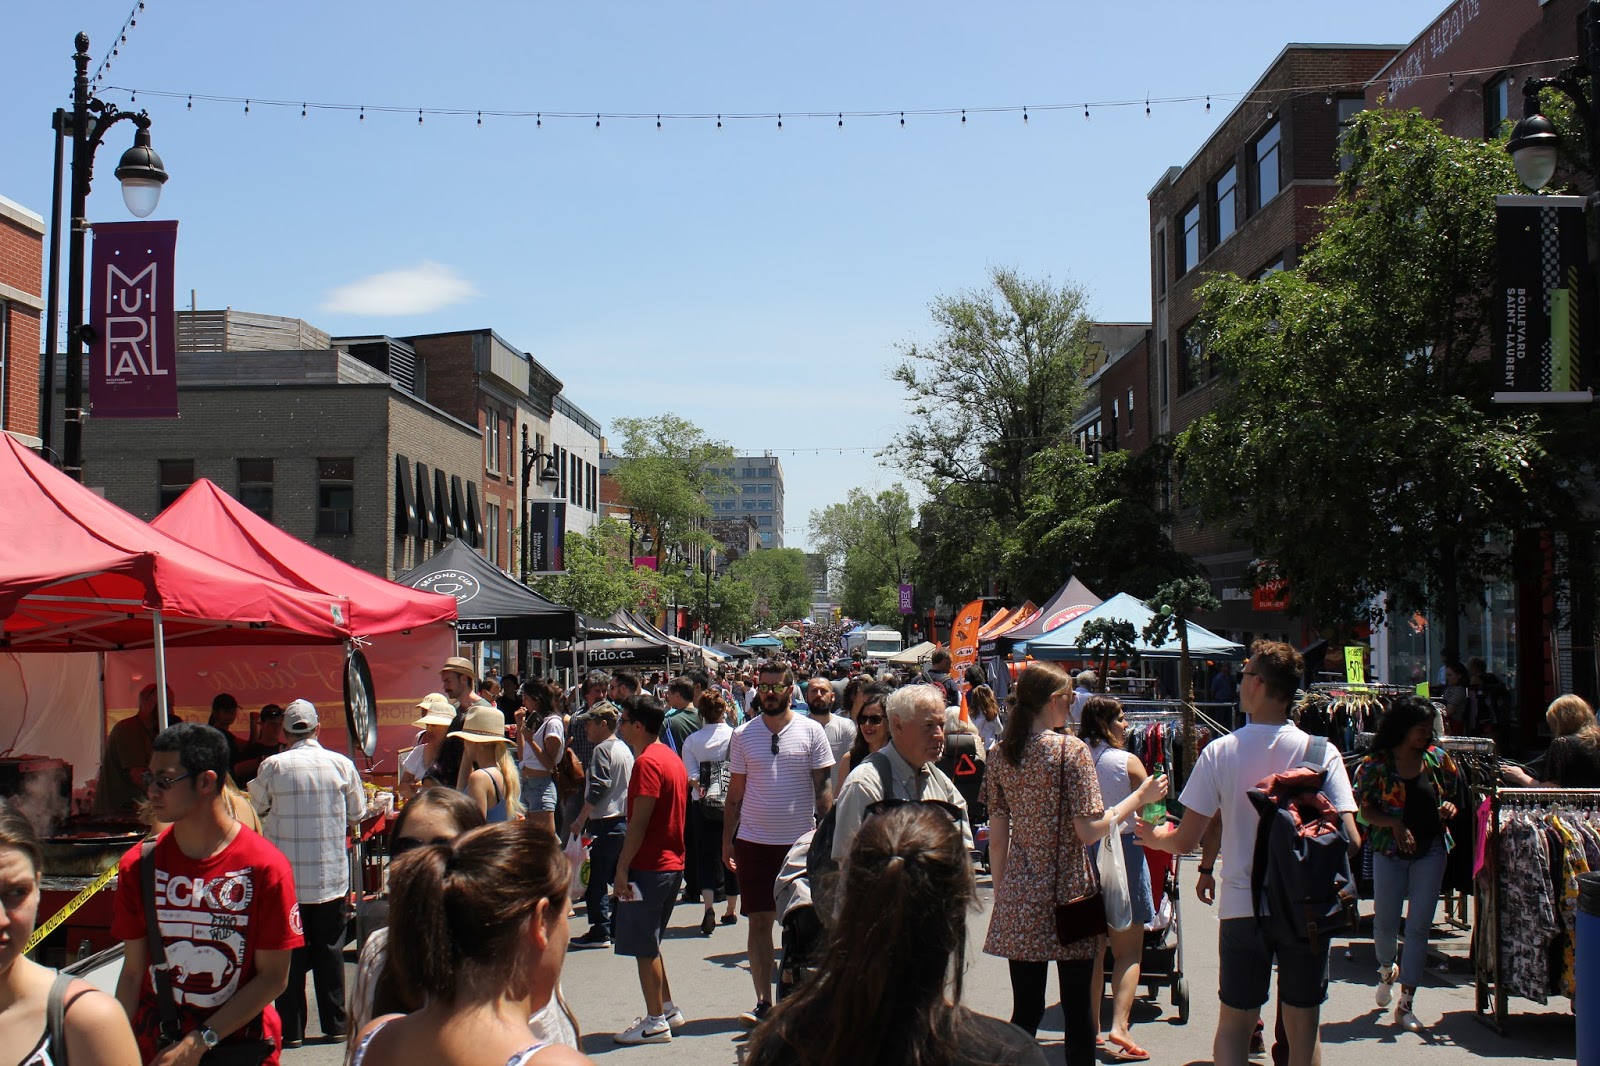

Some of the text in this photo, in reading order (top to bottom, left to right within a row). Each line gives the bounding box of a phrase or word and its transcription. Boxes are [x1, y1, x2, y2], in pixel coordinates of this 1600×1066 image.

[106, 262, 168, 376] MURAL
[1517, 288, 1526, 359] BOULEVARD
[1505, 288, 1516, 387] SAINT-LAURENT
[420, 572, 473, 587] SECOND CUP
[457, 621, 471, 630] AFÉ
[588, 649, 635, 661] fido.ca
[45, 908, 66, 933] CAUTION
